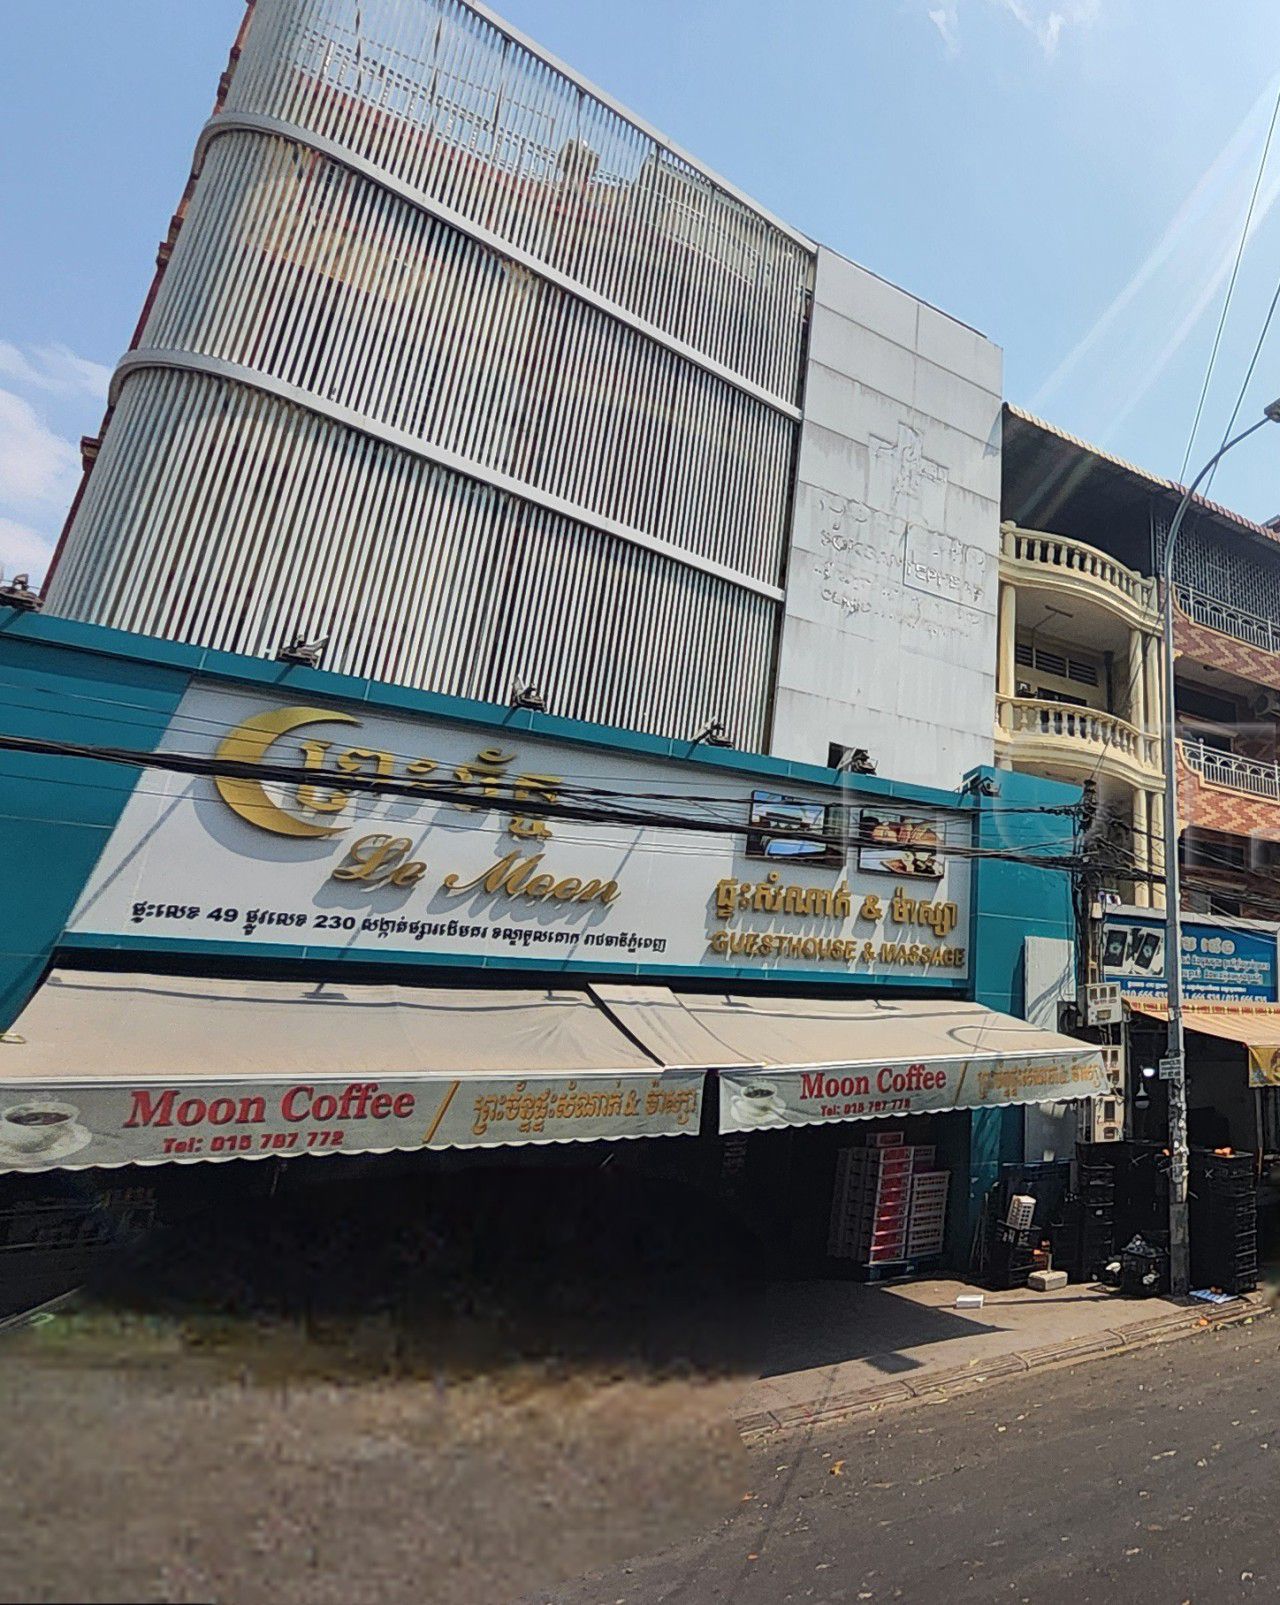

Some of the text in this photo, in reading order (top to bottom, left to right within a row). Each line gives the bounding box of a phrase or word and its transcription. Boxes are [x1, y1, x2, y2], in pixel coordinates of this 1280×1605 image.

[332, 834, 622, 904] Le Moon
[207, 907, 238, 922] 49
[313, 915, 355, 930] 230
[861, 895, 883, 920] &
[711, 930, 965, 967] GUESTHOUSE & MASSAGE
[800, 1072, 869, 1099] Moon
[877, 1064, 946, 1093] Coffee
[122, 1083, 416, 1128] Moon Coffee
[821, 1104, 841, 1116] Tel:
[163, 1138, 203, 1154] Tel:
[210, 1135, 252, 1151] 015
[307, 1130, 345, 1147] 772
